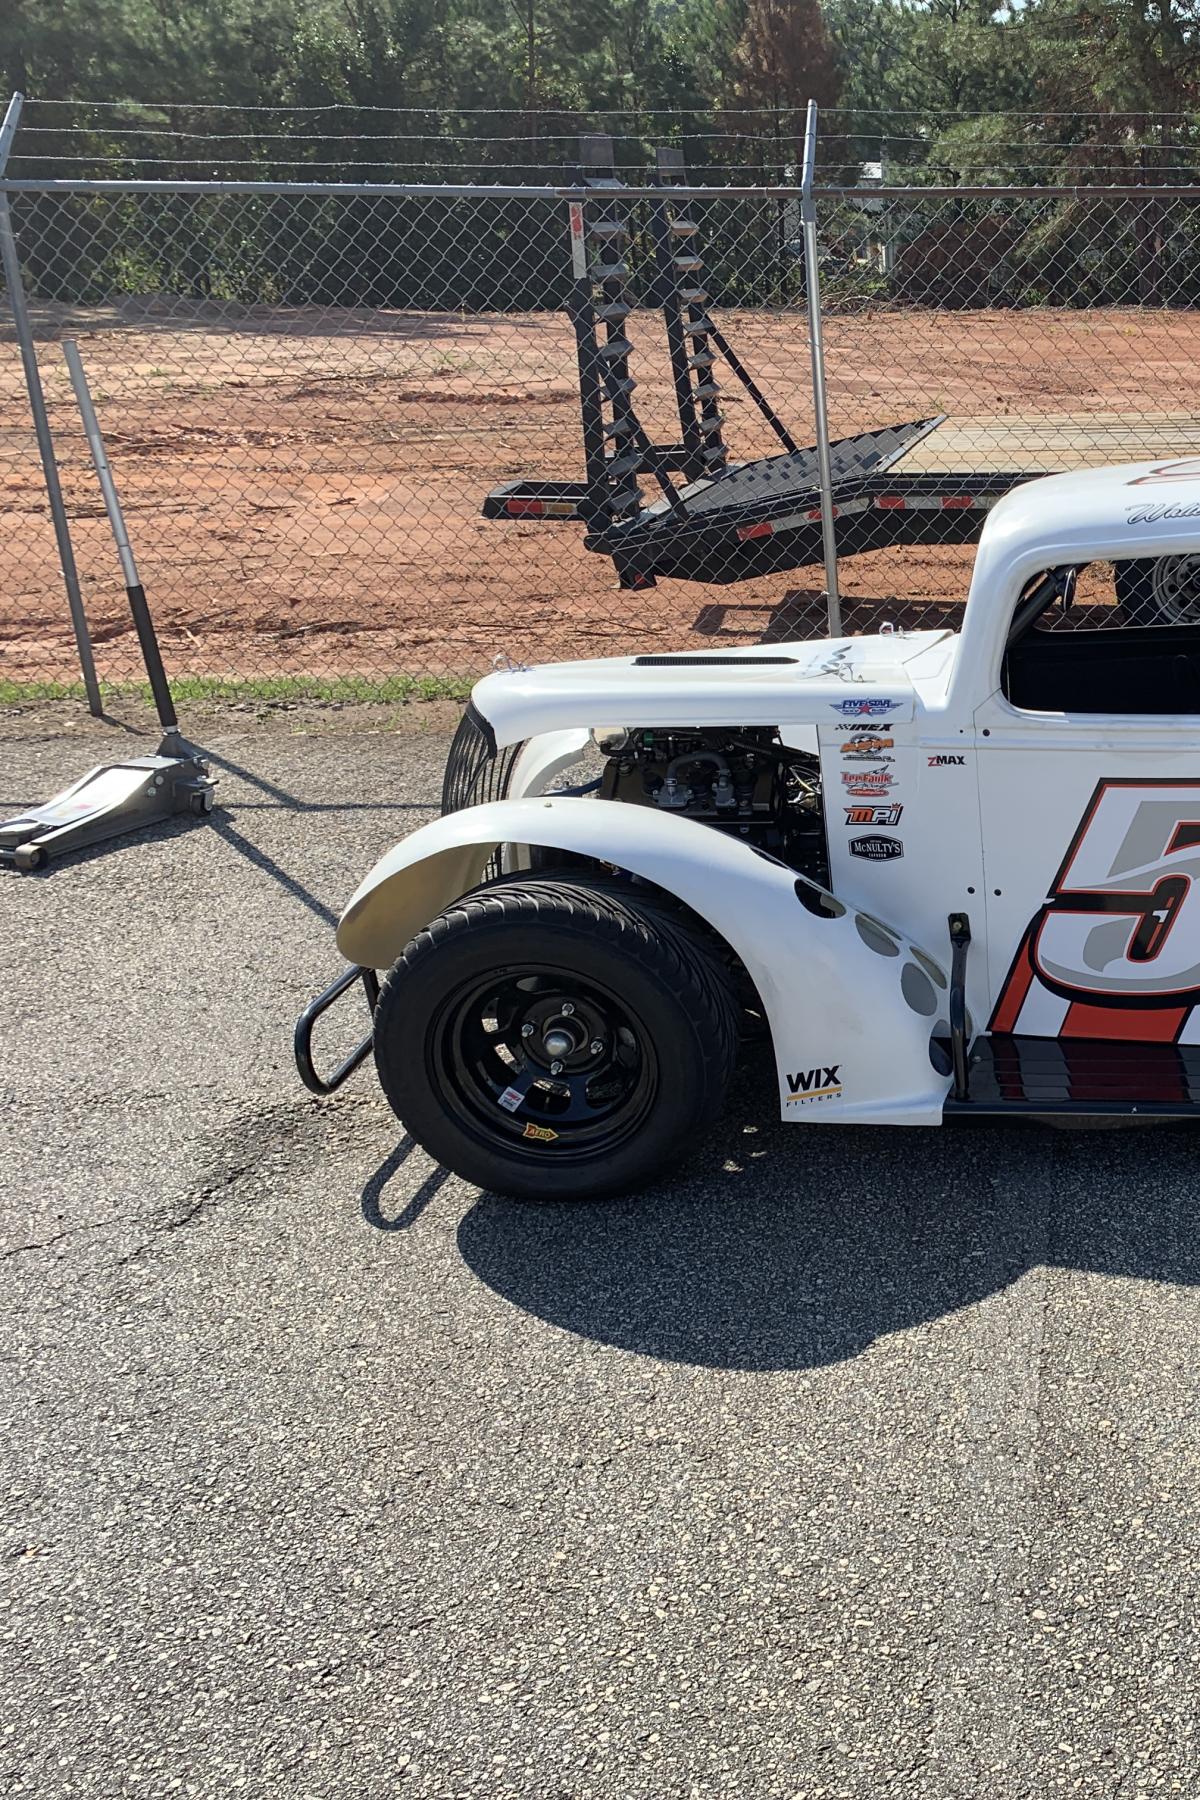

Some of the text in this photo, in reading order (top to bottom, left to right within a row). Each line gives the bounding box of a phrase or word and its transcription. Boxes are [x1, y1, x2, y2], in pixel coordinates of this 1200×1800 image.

[849, 723, 894, 732] INEX
[786, 1065, 841, 1093] WIX
[786, 1092, 842, 1107] FILTERS
